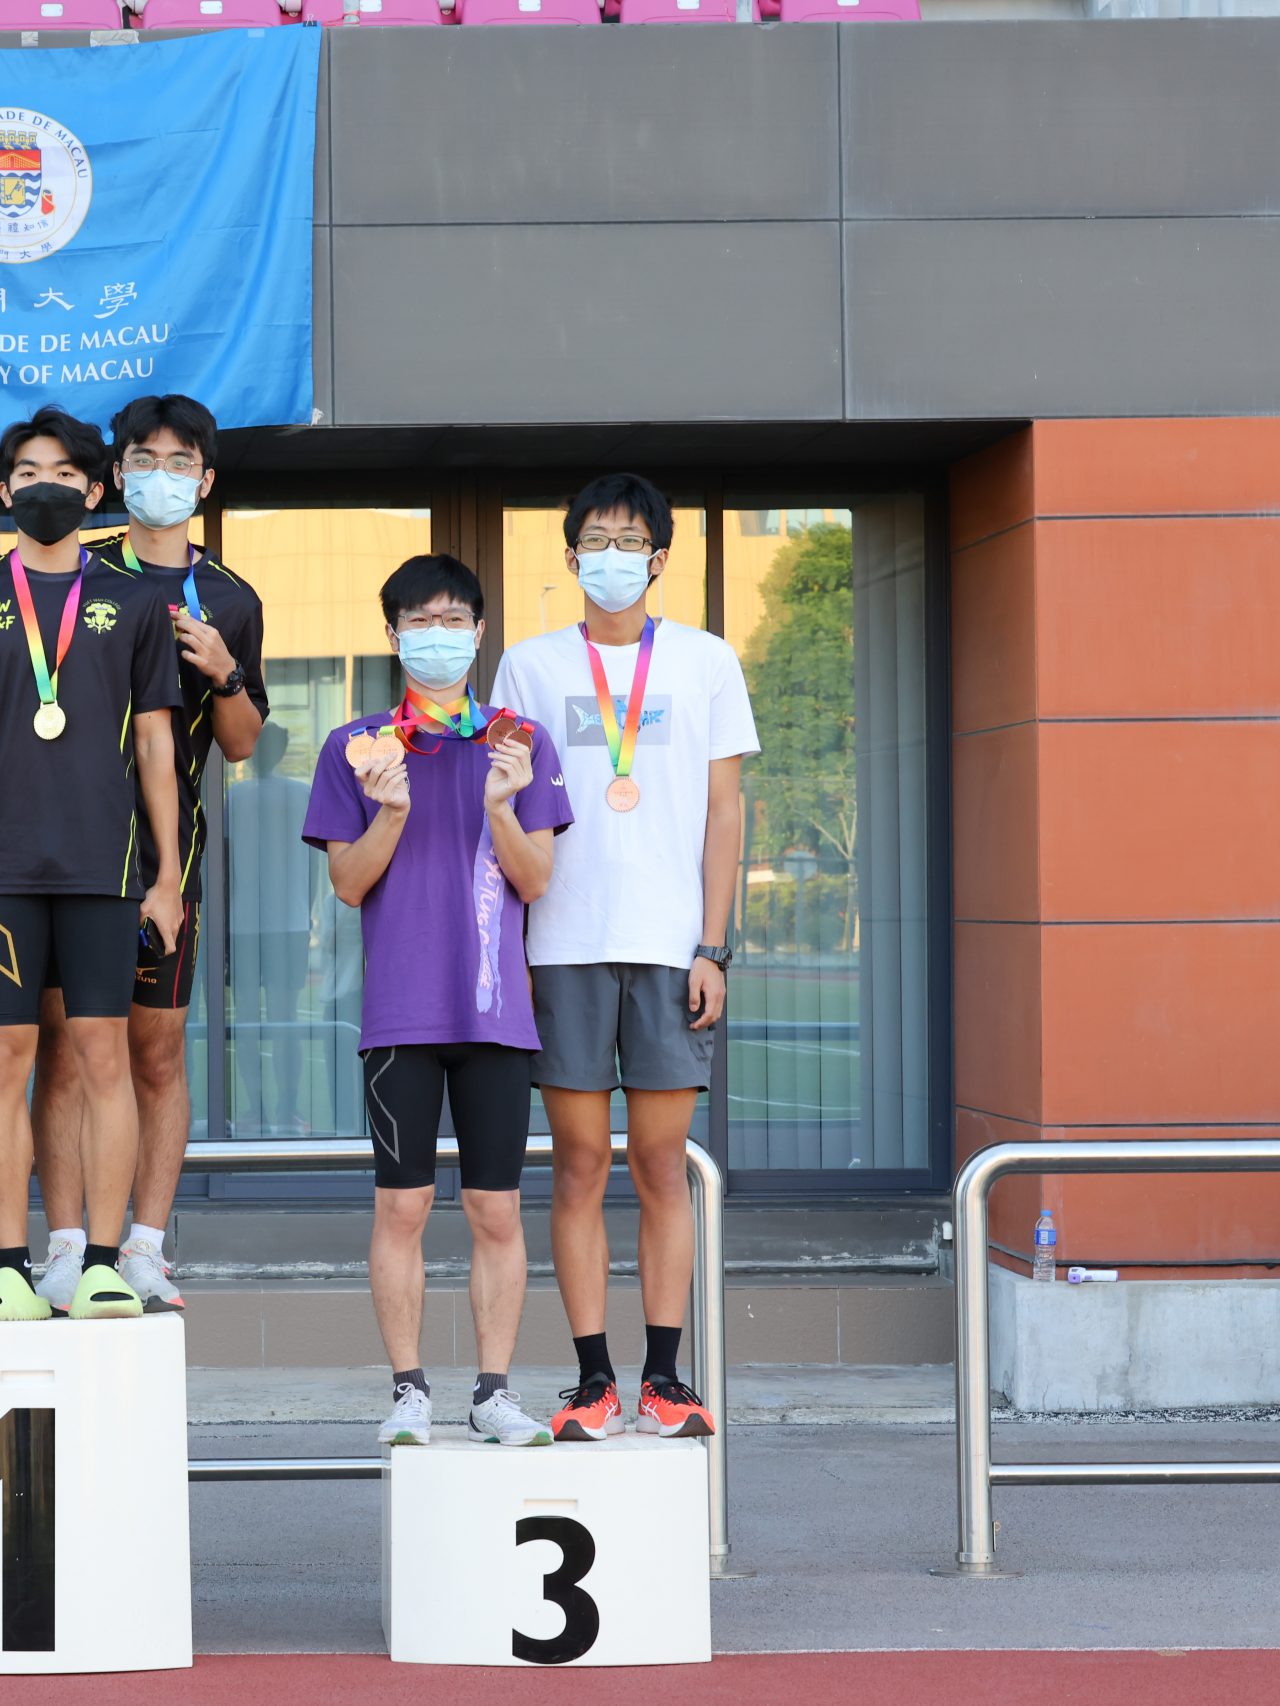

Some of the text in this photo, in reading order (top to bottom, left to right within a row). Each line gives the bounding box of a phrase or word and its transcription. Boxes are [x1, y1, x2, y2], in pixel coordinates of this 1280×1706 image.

[32, 115, 53, 131] DE
[54, 129, 89, 179] MACAU
[40, 333, 71, 353] DE
[80, 323, 169, 351] MACAU
[19, 364, 53, 385] OF
[61, 357, 153, 384] MACAU
[512, 1515, 600, 1664] 3
